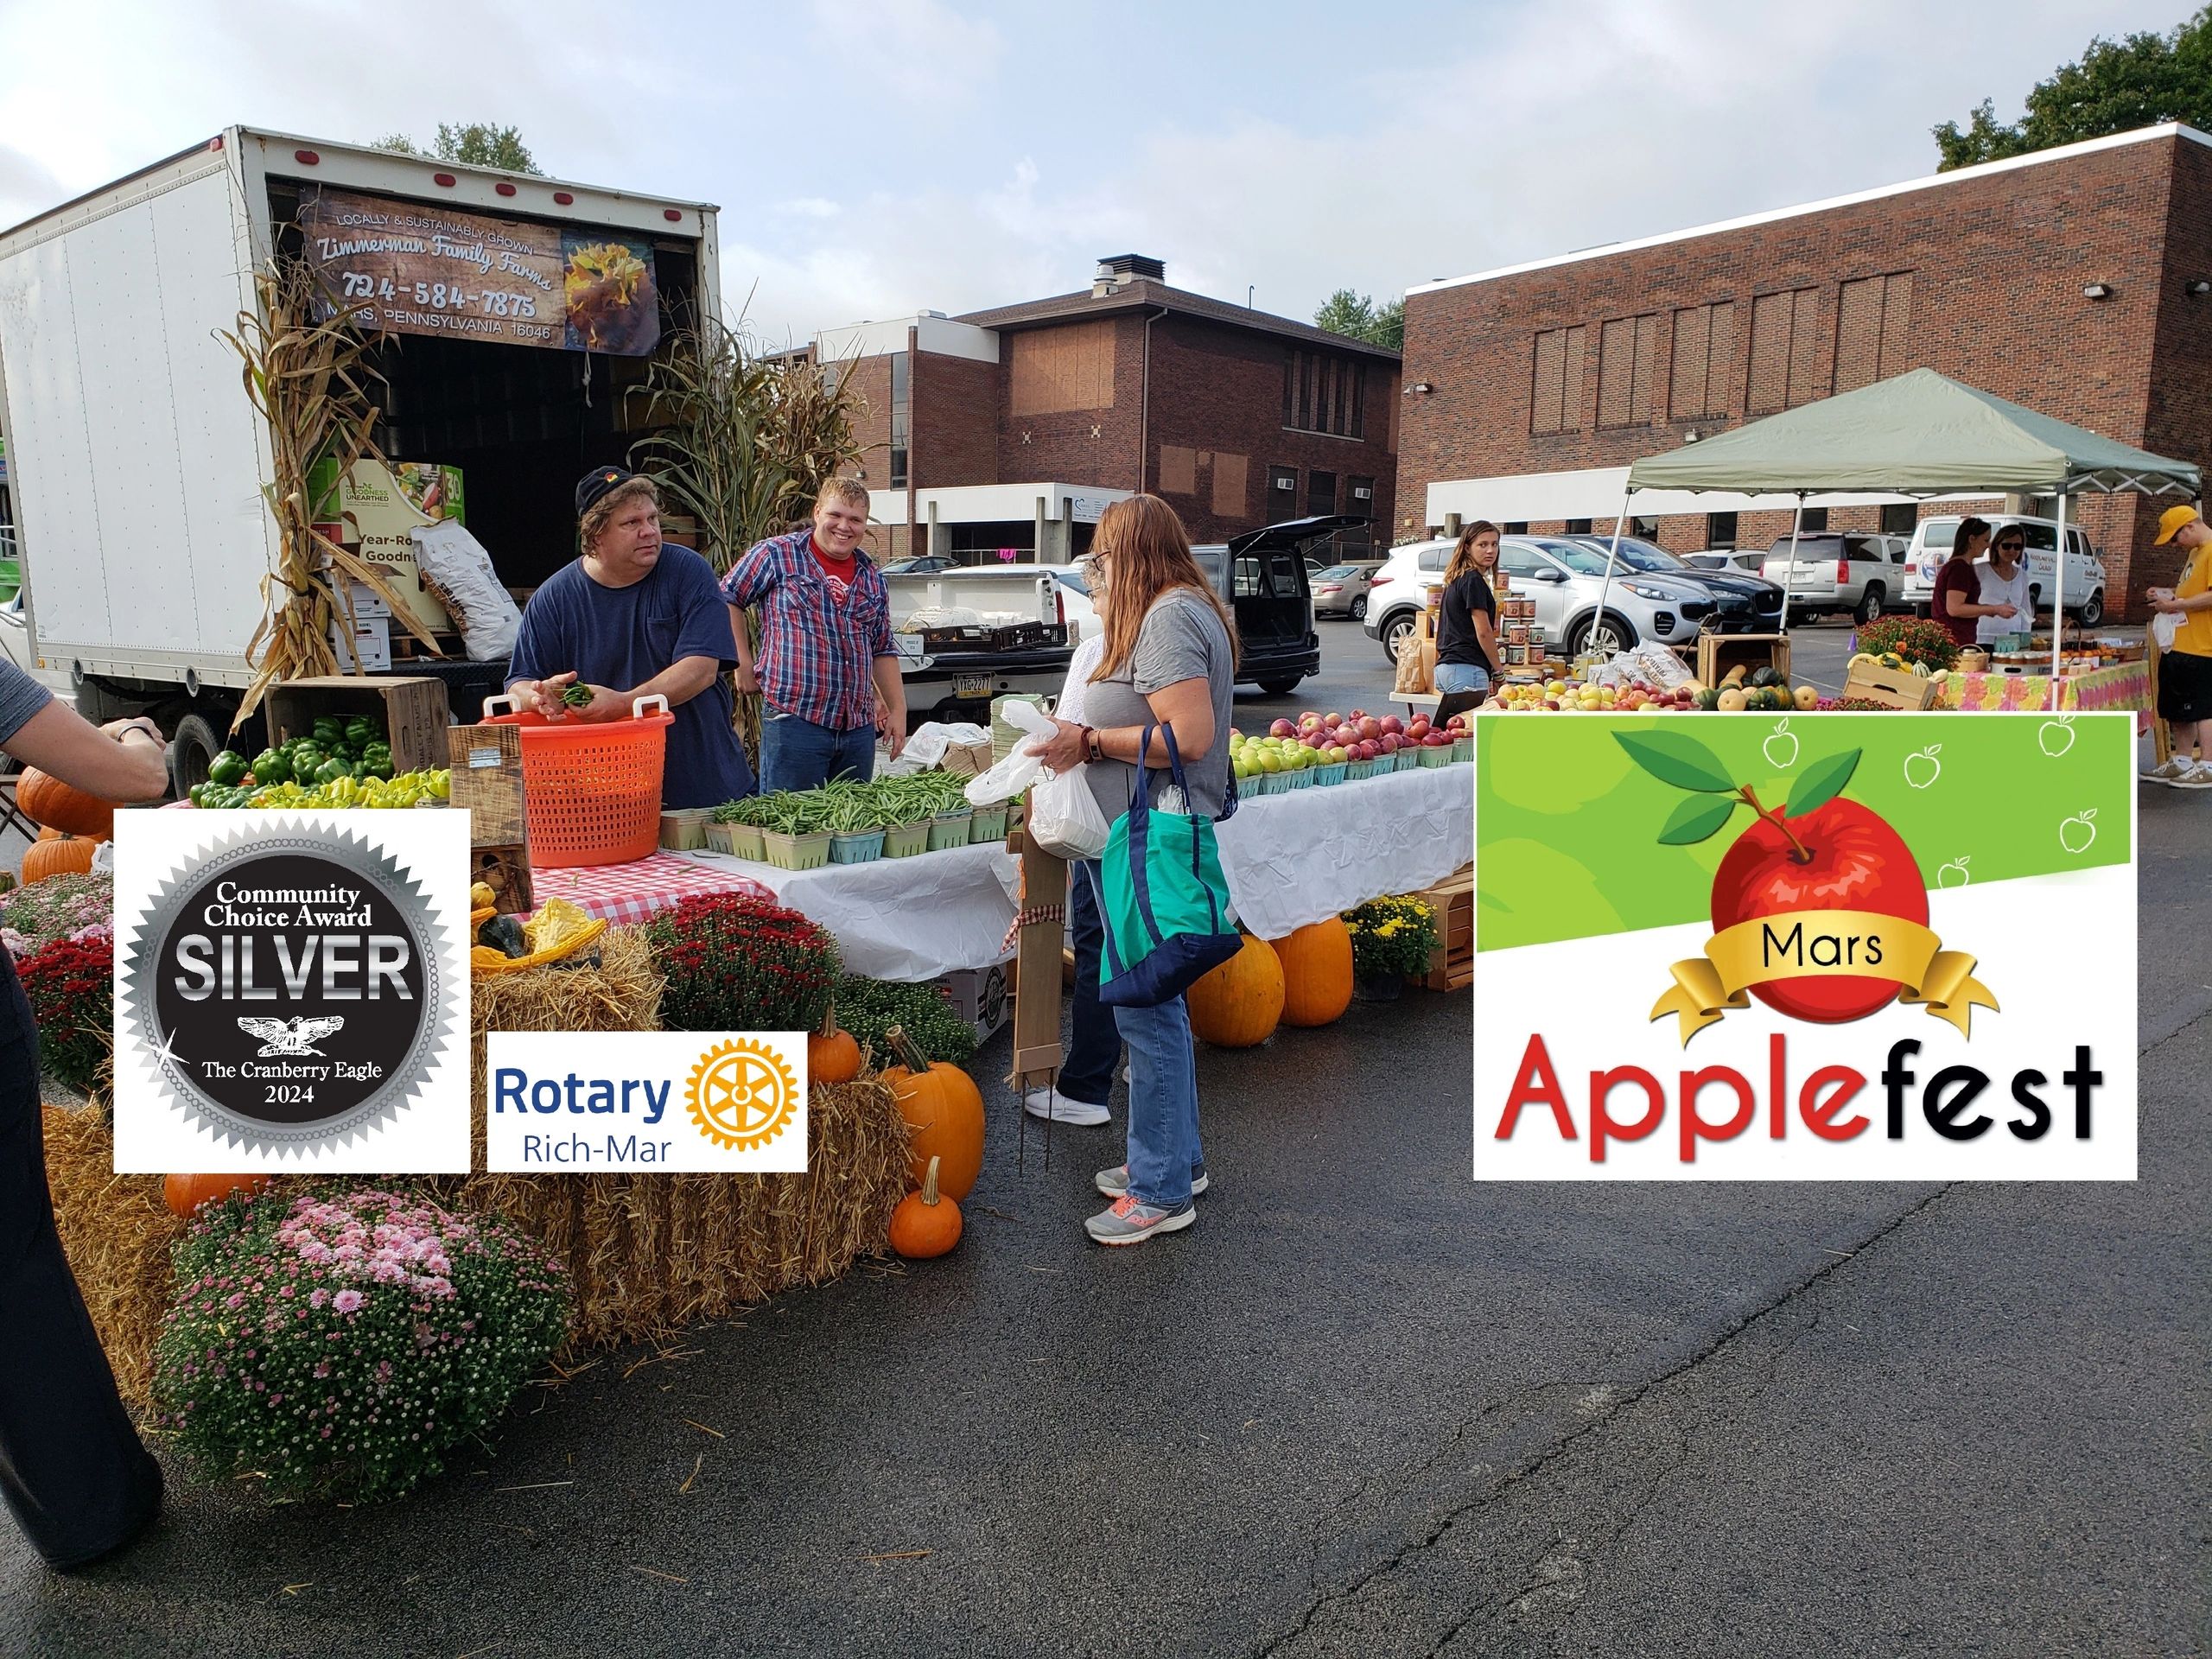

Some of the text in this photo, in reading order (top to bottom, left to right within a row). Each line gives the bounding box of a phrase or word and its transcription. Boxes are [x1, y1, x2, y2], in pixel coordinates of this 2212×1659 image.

[336, 214, 534, 256] LOCALLY & SUSTAINABLY GROWN
[316, 234, 552, 291] Zimmerman Family Farms
[342, 271, 537, 318] 724-584-7875
[384, 308, 503, 334] PENNSYLVANIA
[511, 322, 551, 340] 16046
